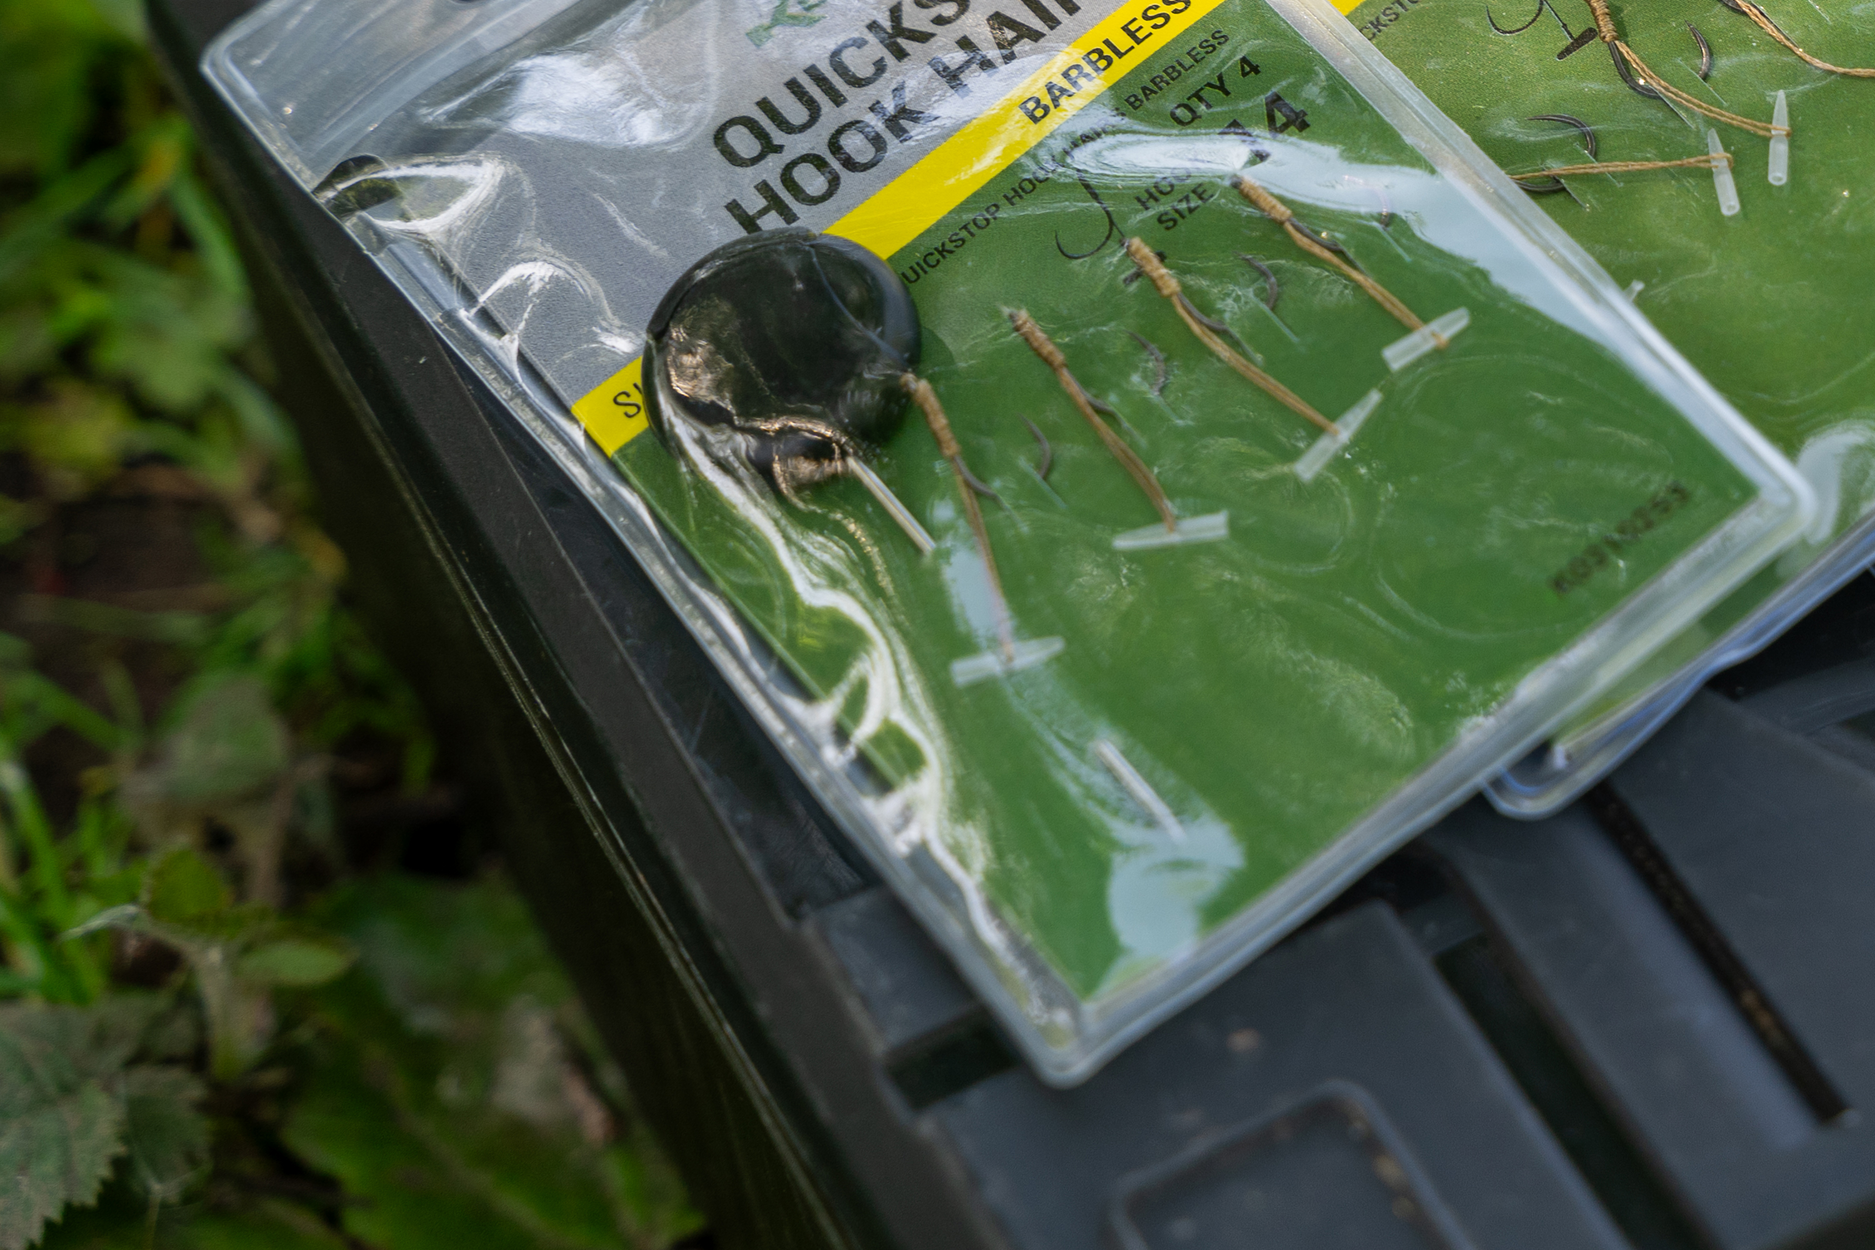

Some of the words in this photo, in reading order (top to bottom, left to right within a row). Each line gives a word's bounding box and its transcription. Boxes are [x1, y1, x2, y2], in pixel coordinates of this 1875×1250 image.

[1124, 29, 1231, 111] BARBLESS
[1169, 71, 1233, 127] QTY
[1238, 55, 1262, 79] 4
[721, 81, 940, 234] HOOK
[1217, 90, 1311, 163] 14
[1156, 182, 1215, 231] SIZE
